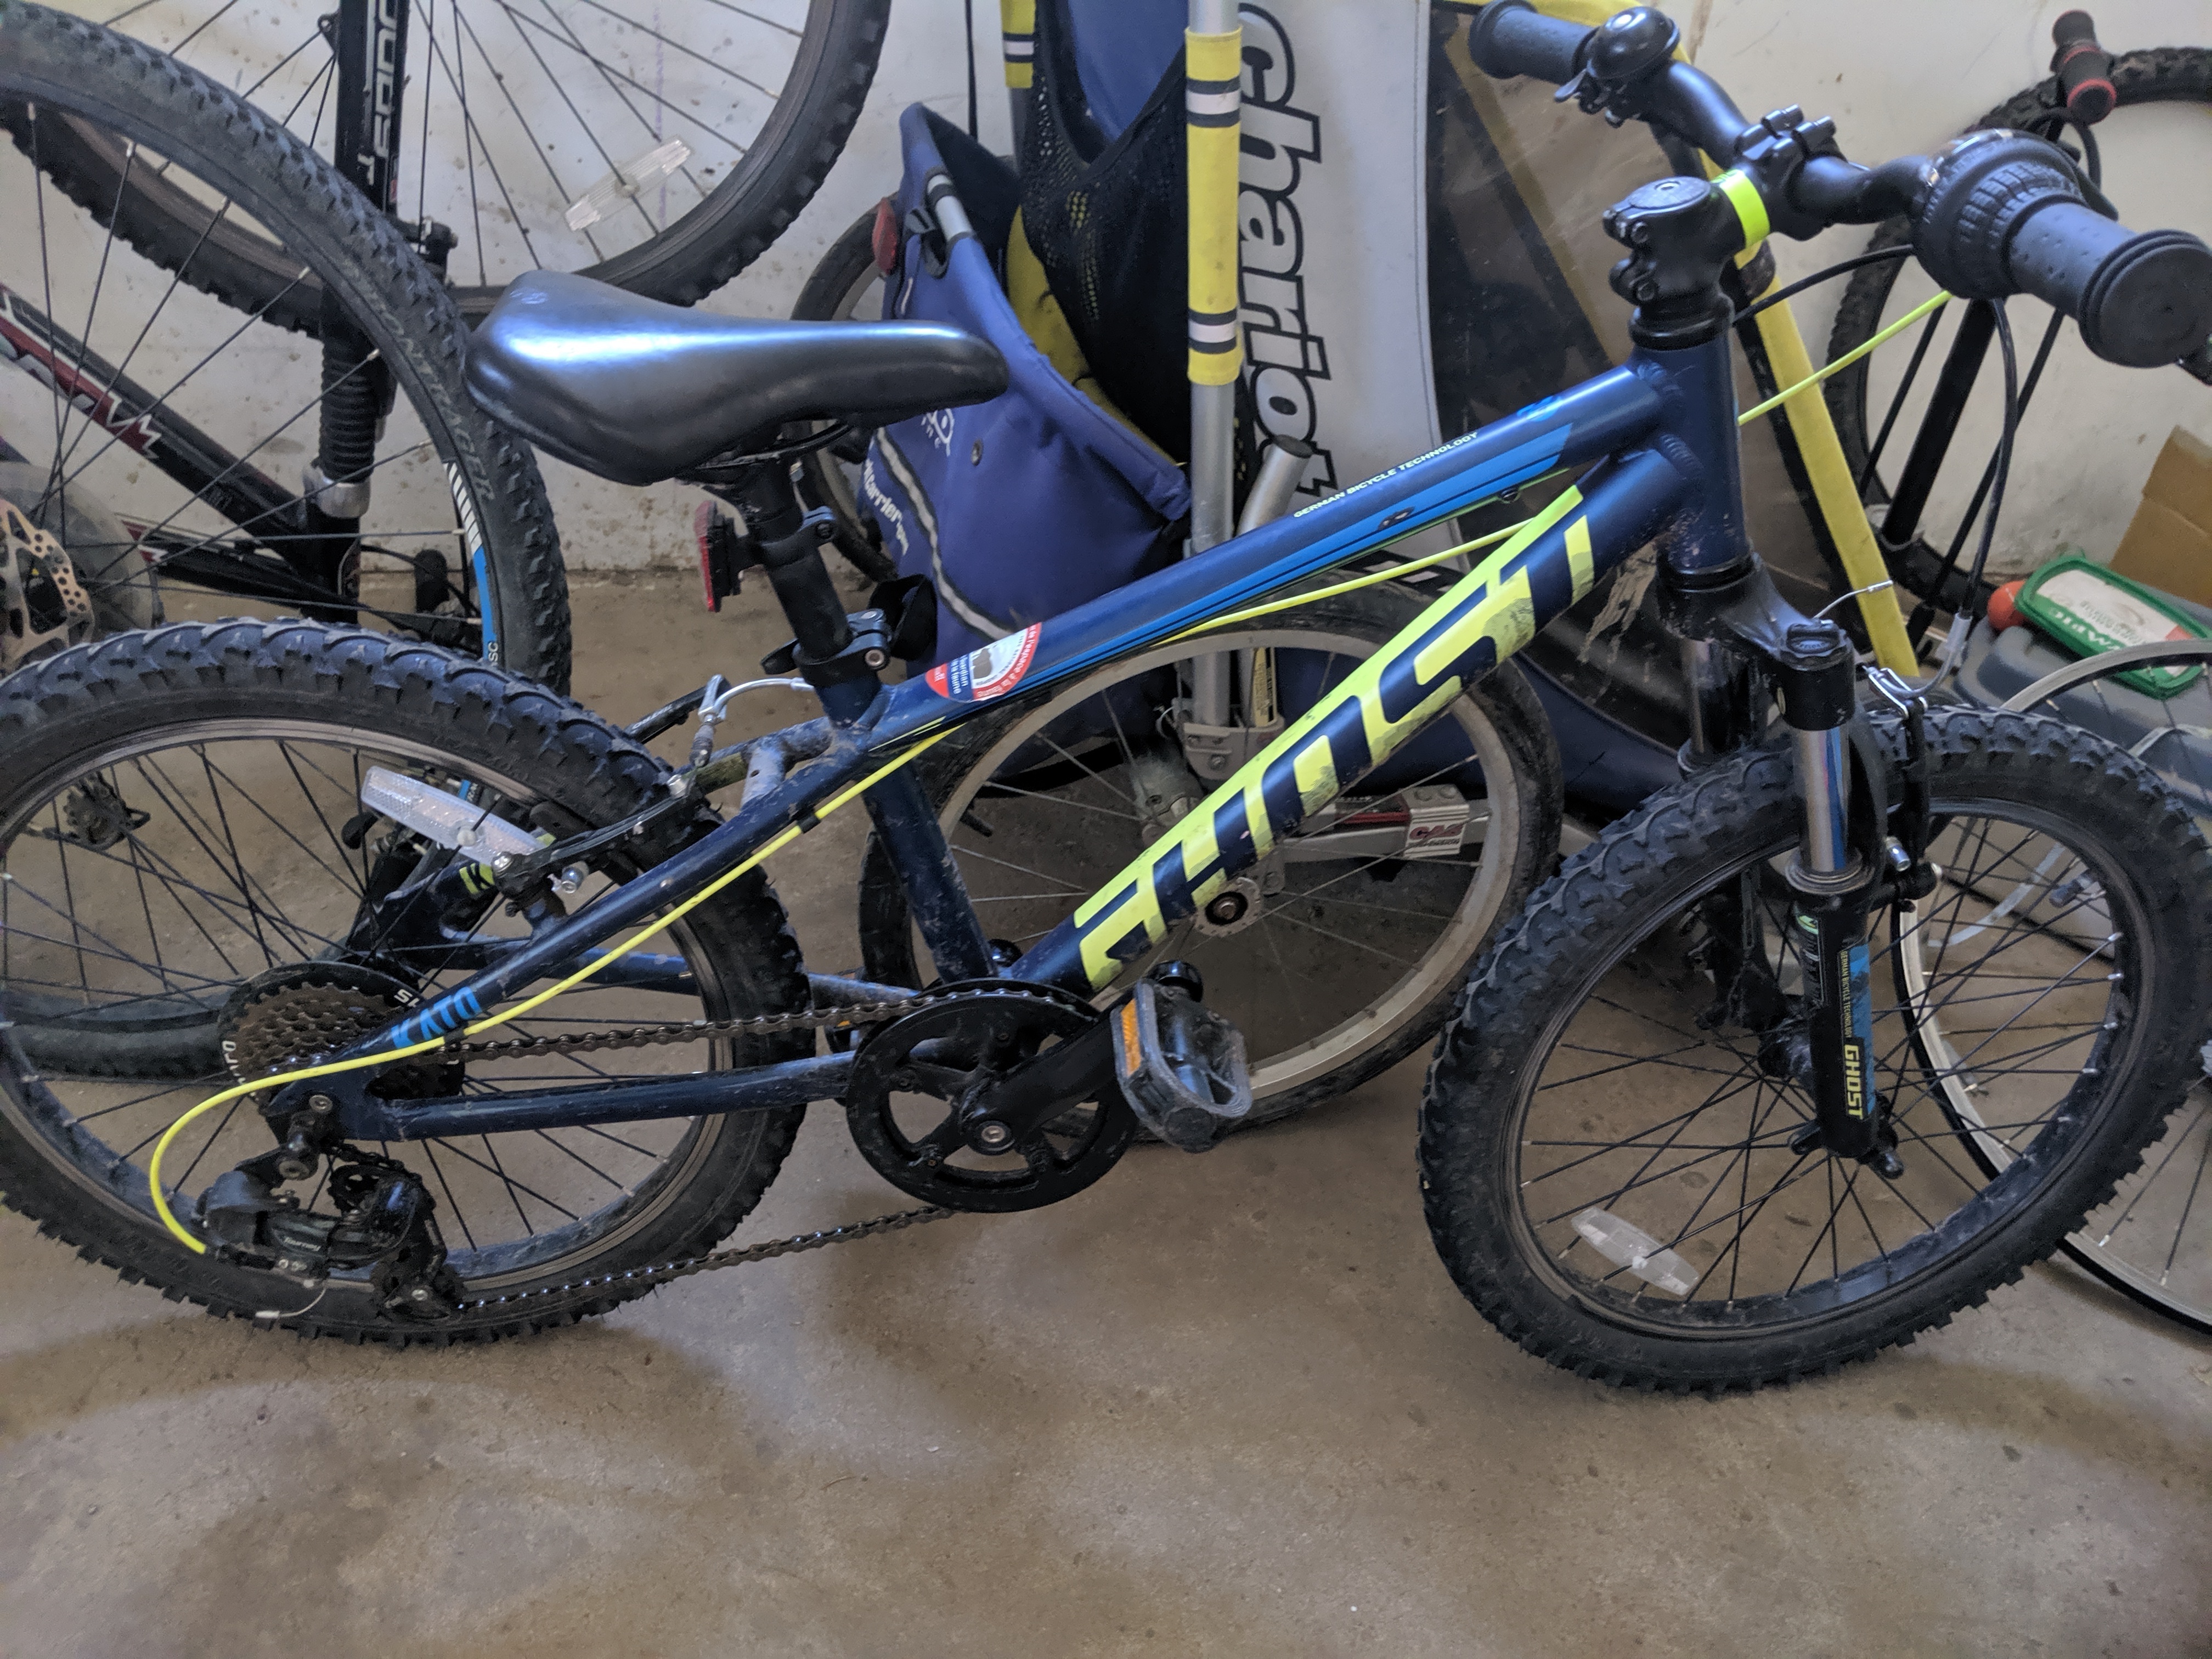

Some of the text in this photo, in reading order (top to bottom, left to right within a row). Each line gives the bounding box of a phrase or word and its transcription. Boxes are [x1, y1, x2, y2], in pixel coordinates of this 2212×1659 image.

[1294, 432, 1478, 518] GERMAN BICYCLE TECHNOLOGY
[1074, 484, 1594, 988] GHOST
[391, 986, 483, 1049] KATO
[1840, 950, 1853, 1039] GERMAN BICYCLE TECHNOLOGY
[1844, 1044, 1863, 1120] GHOST
